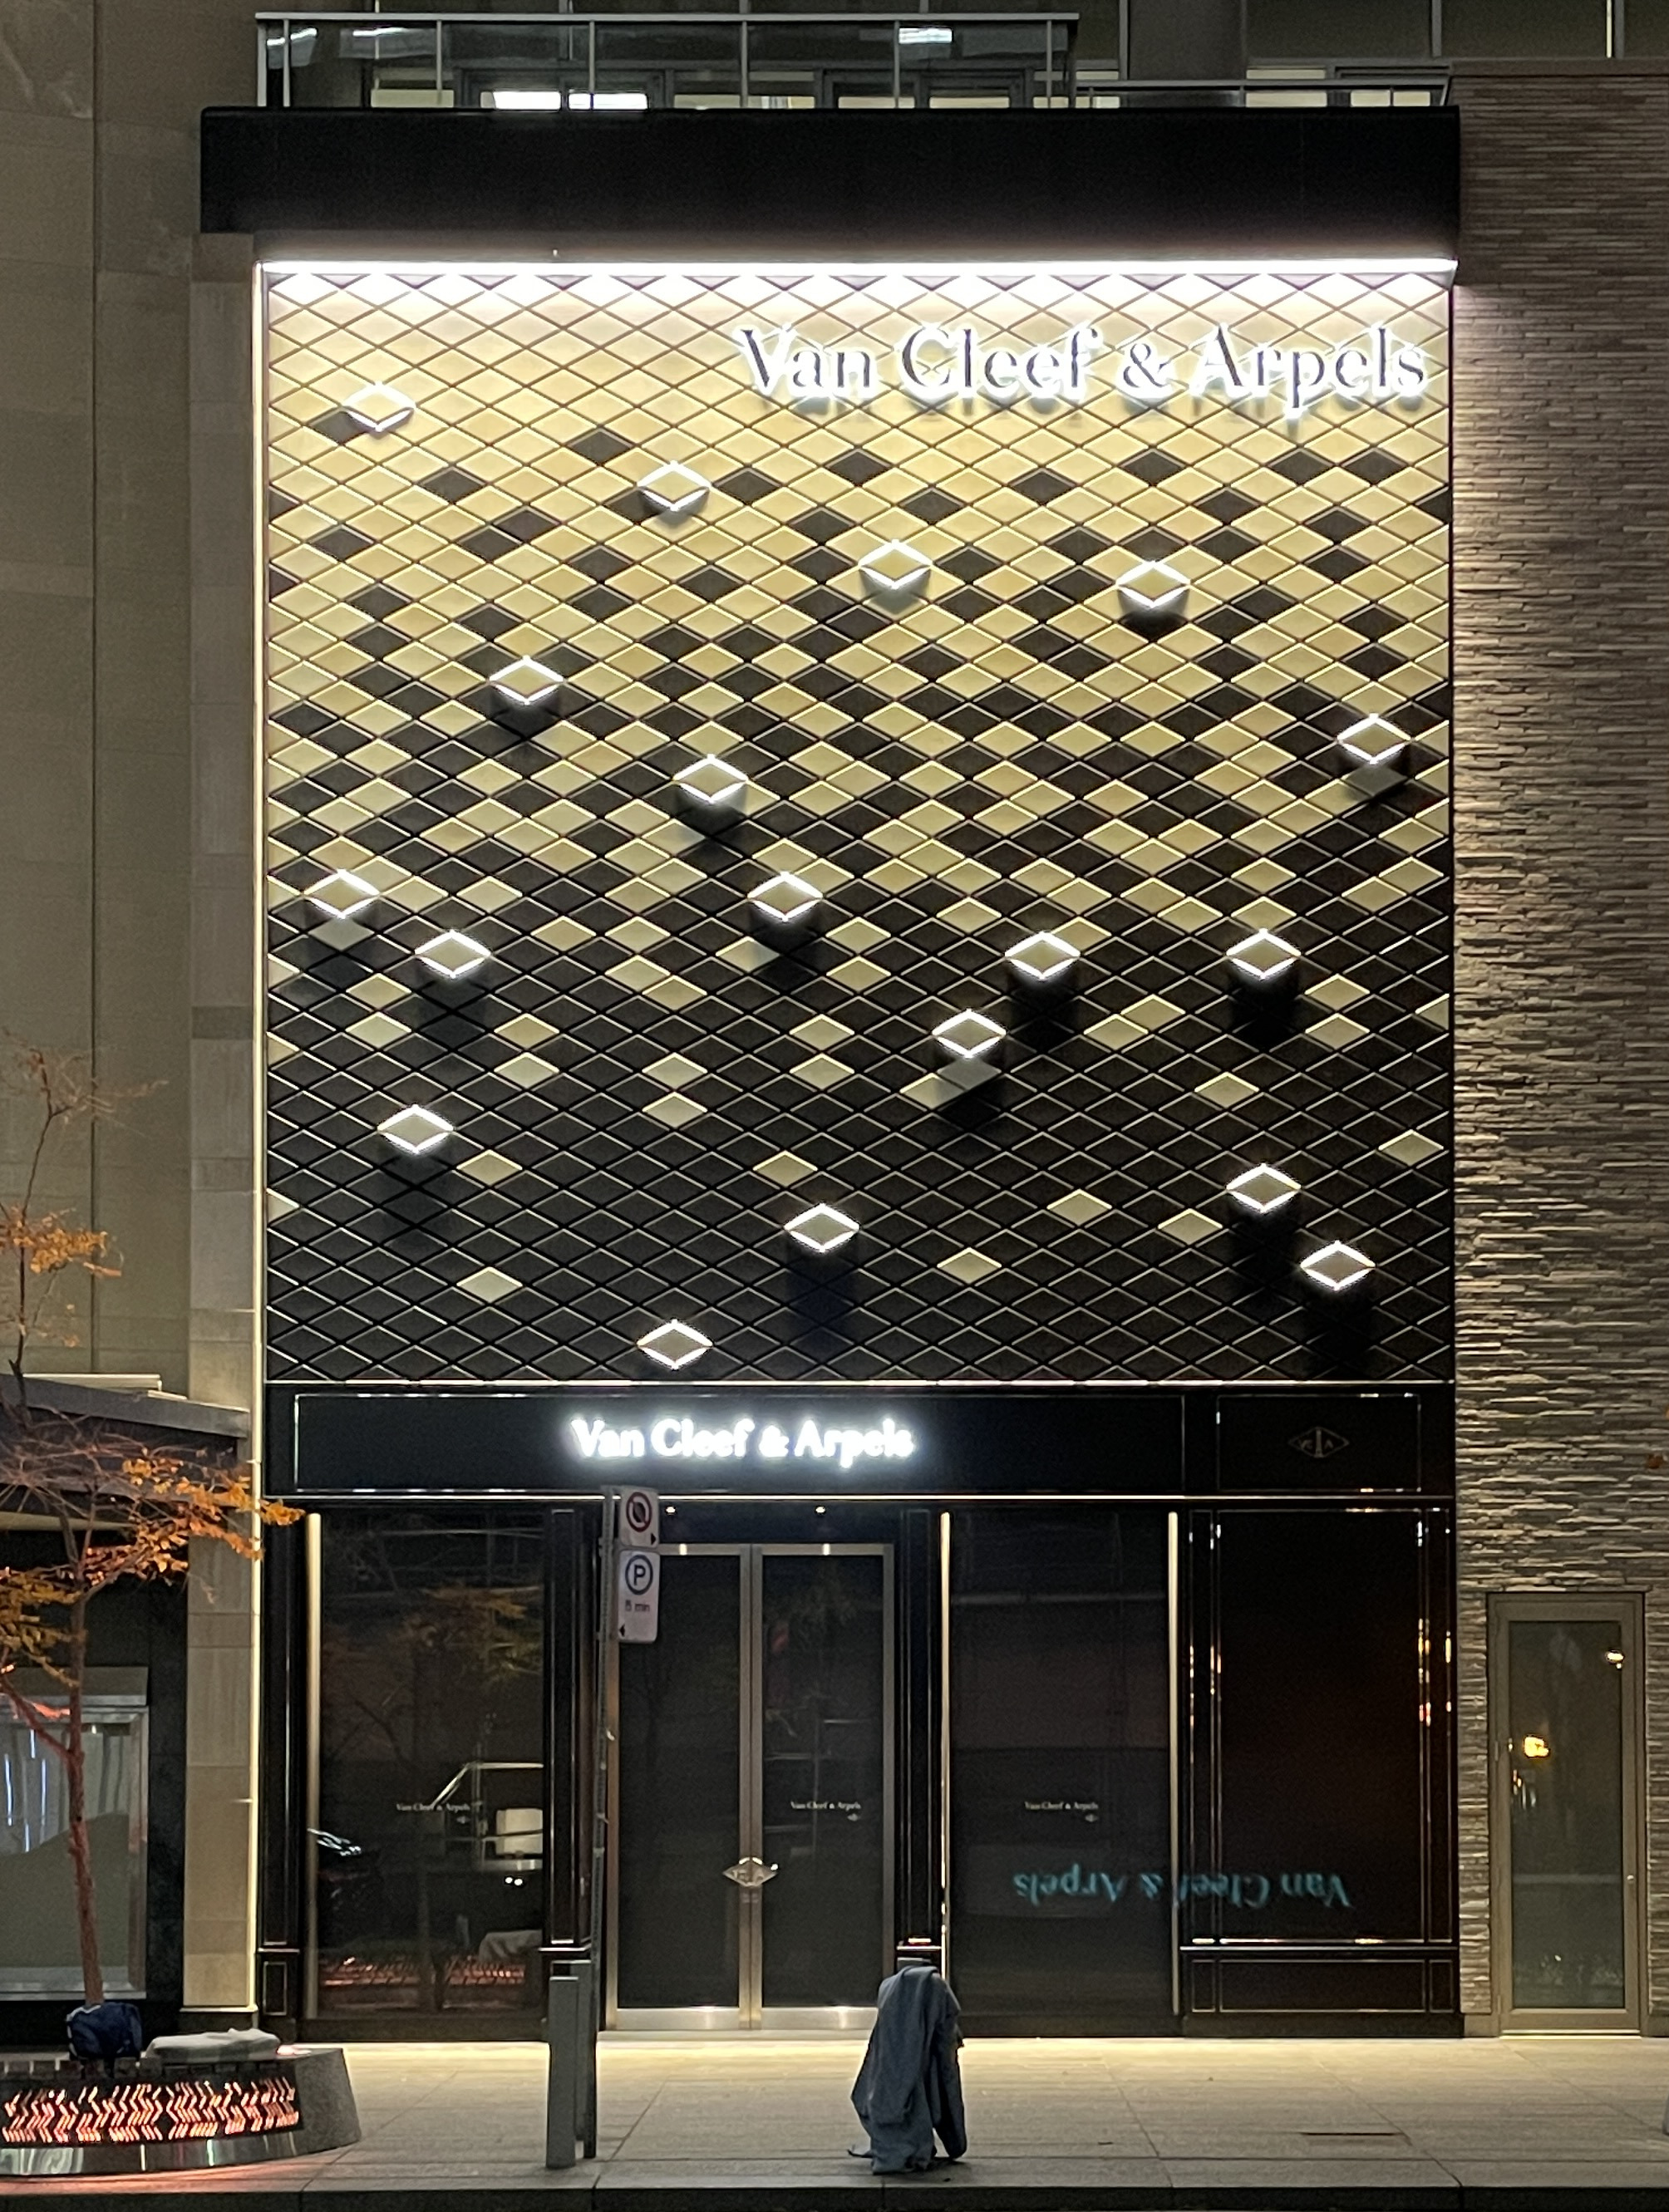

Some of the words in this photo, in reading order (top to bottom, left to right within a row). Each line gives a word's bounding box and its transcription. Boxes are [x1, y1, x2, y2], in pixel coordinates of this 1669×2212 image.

[736, 326, 874, 391] Van
[899, 323, 1101, 391] Cleef
[1121, 341, 1173, 391] &
[1189, 324, 1425, 412] Arpels
[571, 1418, 645, 1458] Van
[651, 1418, 756, 1458] Cleef
[758, 1424, 790, 1458] &
[794, 1418, 914, 1469] Arpels
[1012, 1863, 1127, 1907] Arpels
[1281, 1872, 1354, 1908] Van
